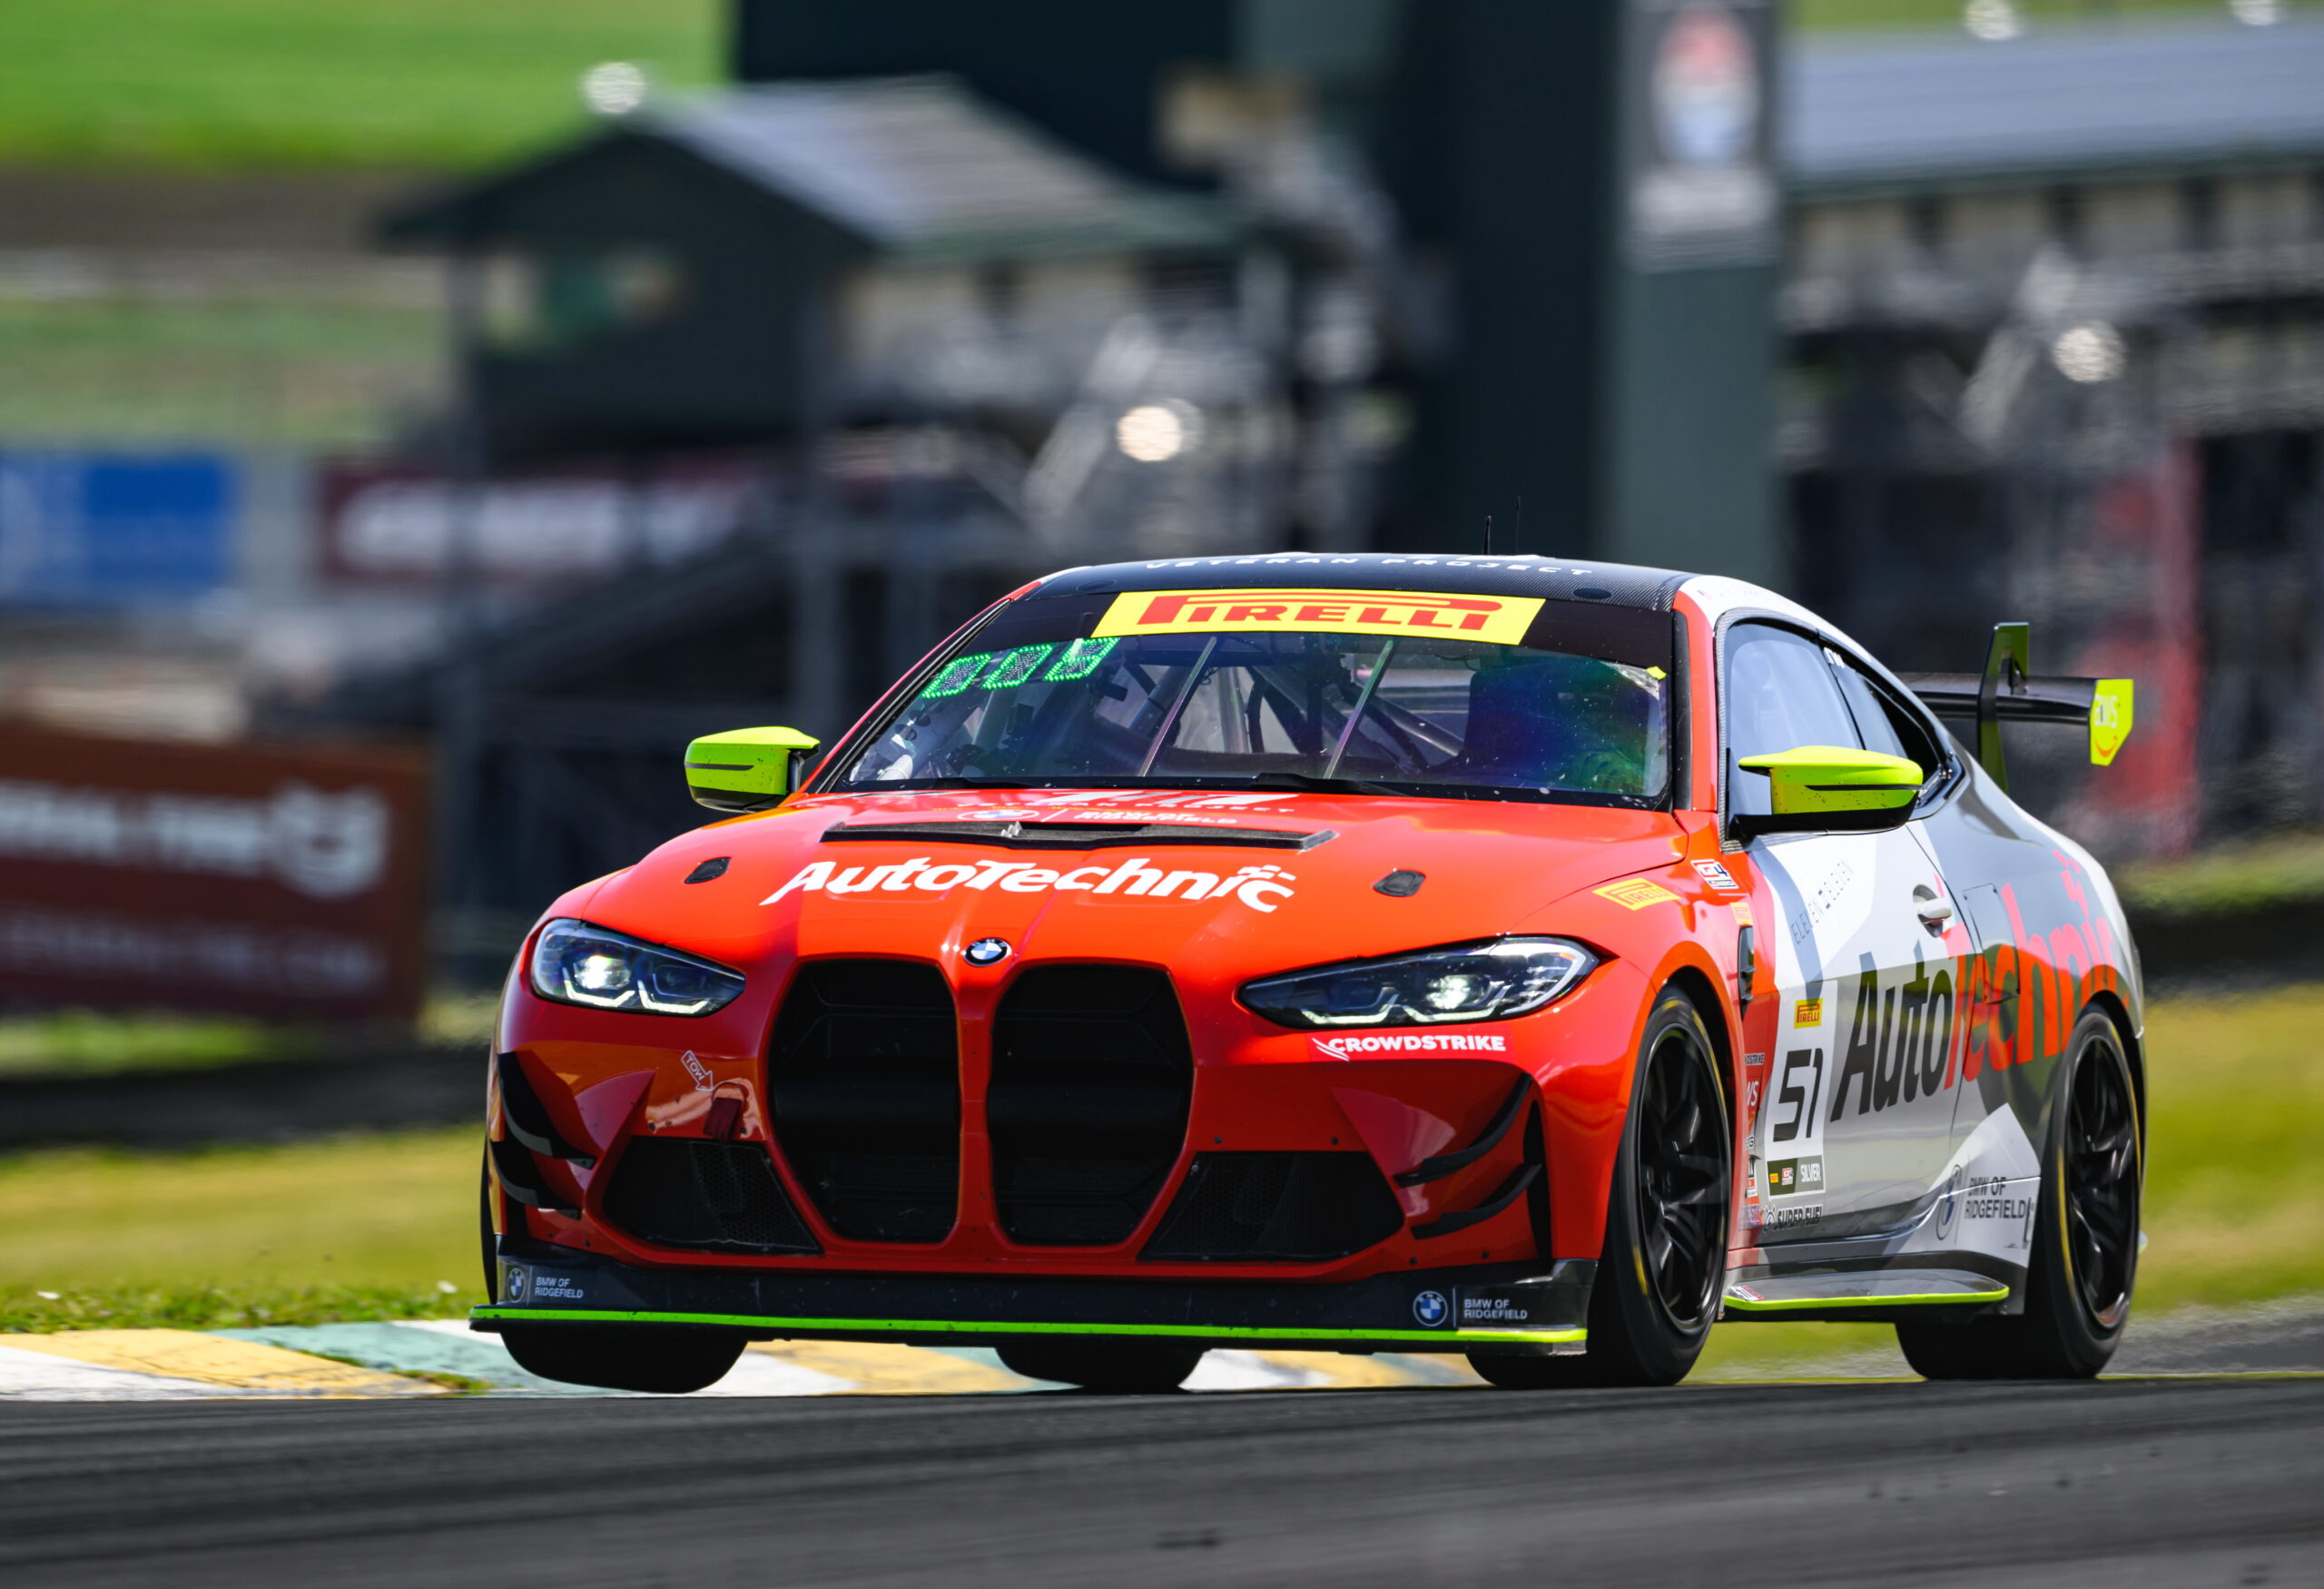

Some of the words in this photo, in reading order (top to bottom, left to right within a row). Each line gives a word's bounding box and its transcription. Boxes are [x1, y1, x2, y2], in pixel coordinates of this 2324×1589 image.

[1136, 592, 1503, 632] PIRELLI
[759, 857, 1296, 913] AutoTechnic
[1603, 881, 1669, 904] PIRELLI
[1797, 1002, 1821, 1023] PIRELLI
[1325, 1035, 1506, 1053] CROWDSTRIKE
[685, 1055, 704, 1081] TOW
[1772, 1048, 1823, 1143] 51
[1800, 1163, 1821, 1183] SILVER
[1967, 1177, 1989, 1197] BMW
[1991, 1177, 2006, 1196] OF
[1965, 1199, 2026, 1219] RIDGEFIELD
[535, 1287, 584, 1298] RIDGEFIELD
[536, 1277, 556, 1287] BMW
[558, 1278, 570, 1288] OF
[1464, 1299, 1492, 1308] BMW
[1495, 1299, 1510, 1308] OF
[1463, 1309, 1528, 1319] RIDGEFIELD
